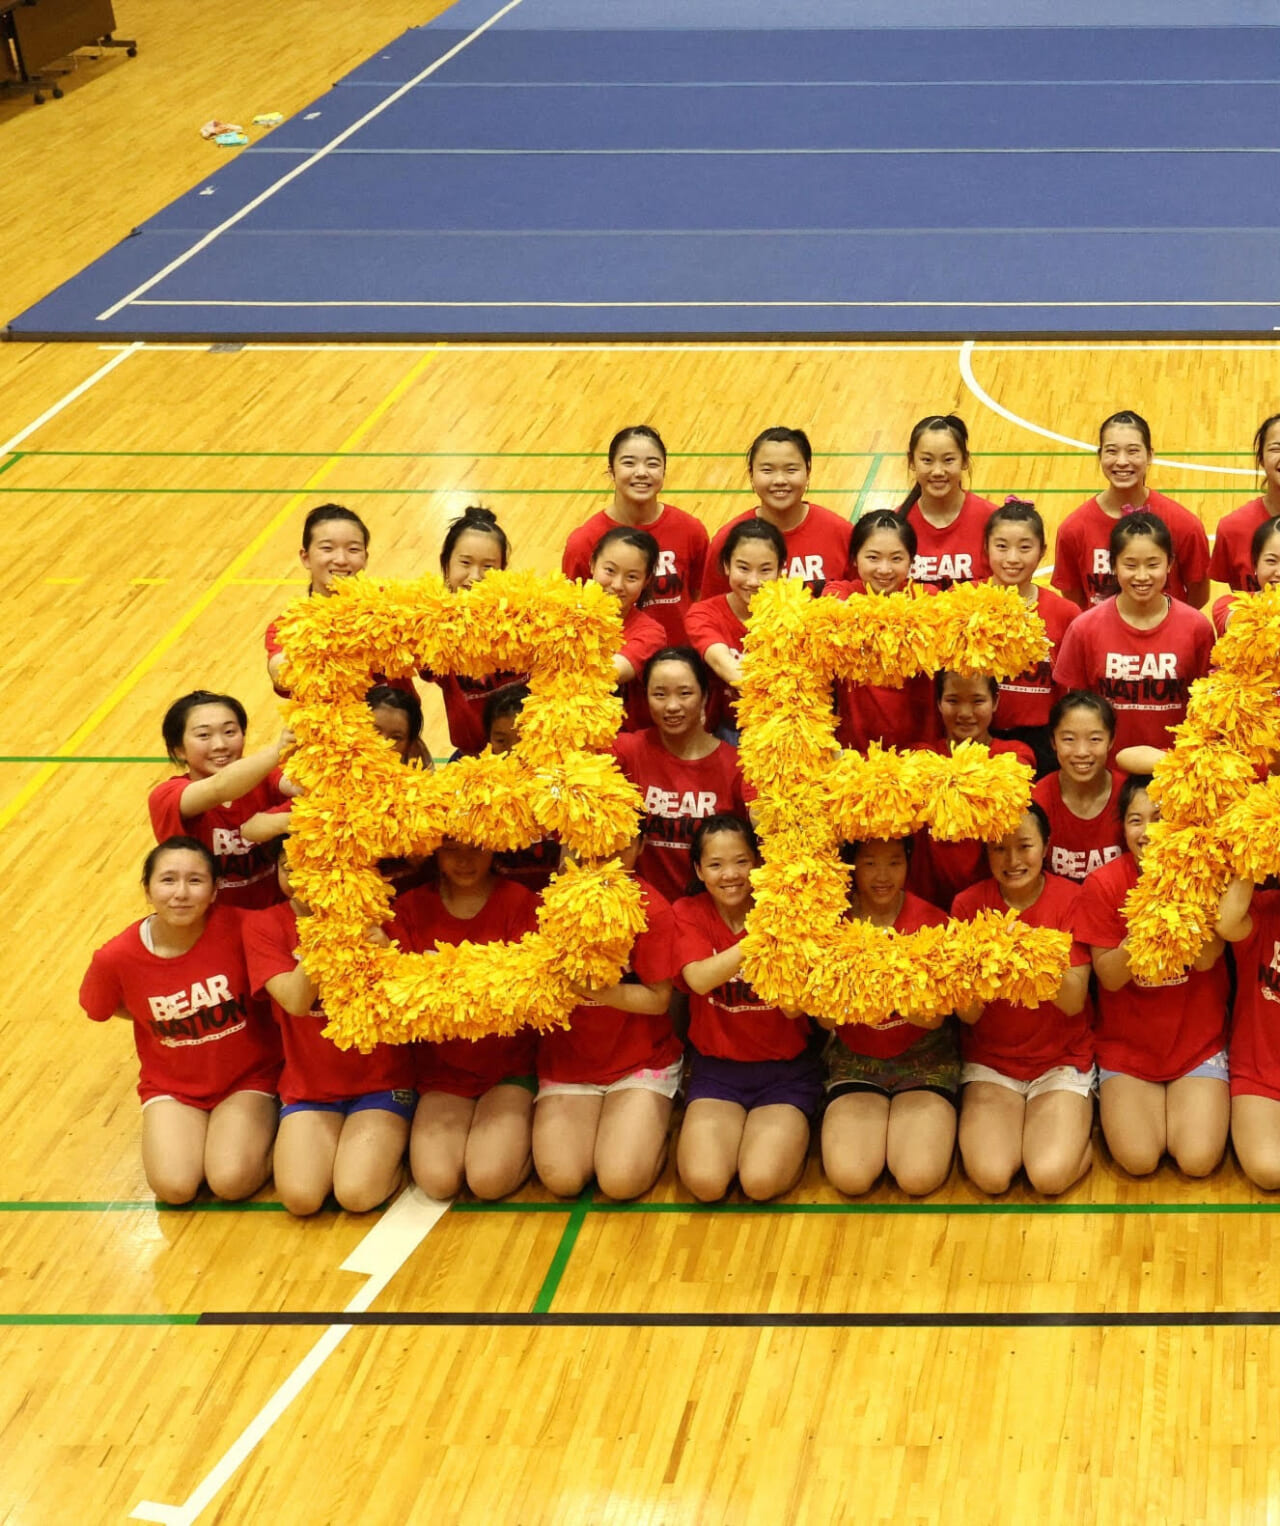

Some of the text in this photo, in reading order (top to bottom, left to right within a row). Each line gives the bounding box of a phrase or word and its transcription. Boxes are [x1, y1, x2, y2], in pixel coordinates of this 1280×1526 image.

[780, 555, 826, 581] AR
[907, 553, 974, 581] BEAR
[1105, 652, 1178, 681] BEAR
[1098, 678, 1186, 704] NATION
[646, 785, 717, 818] BEAR
[213, 828, 256, 855] BE
[147, 974, 234, 1021] BEAR
[149, 992, 247, 1040] NATION
